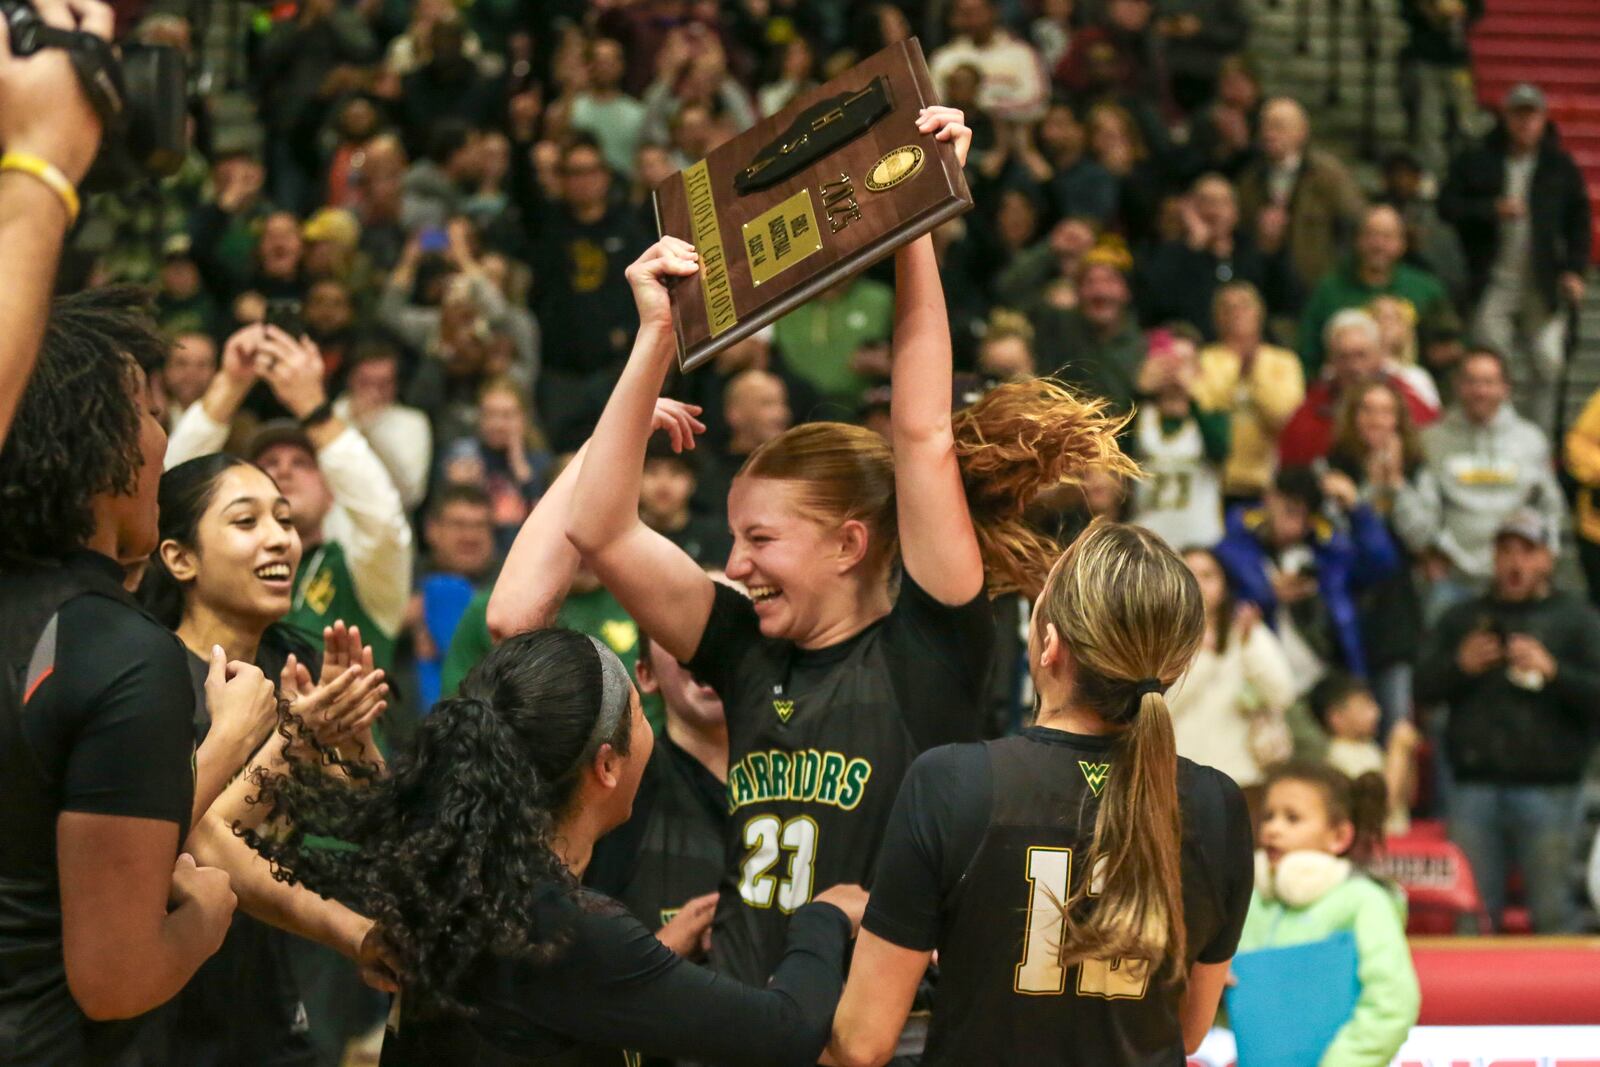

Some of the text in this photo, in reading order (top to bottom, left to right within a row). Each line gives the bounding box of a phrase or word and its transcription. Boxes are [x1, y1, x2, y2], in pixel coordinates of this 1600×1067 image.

[746, 86, 874, 178] IHSA
[768, 214, 791, 261] BASKETBALL
[819, 171, 864, 235] 2025
[687, 168, 733, 328] SECTIONAL CHAMPIONS
[748, 233, 764, 257] CLASS
[738, 813, 819, 915] 23
